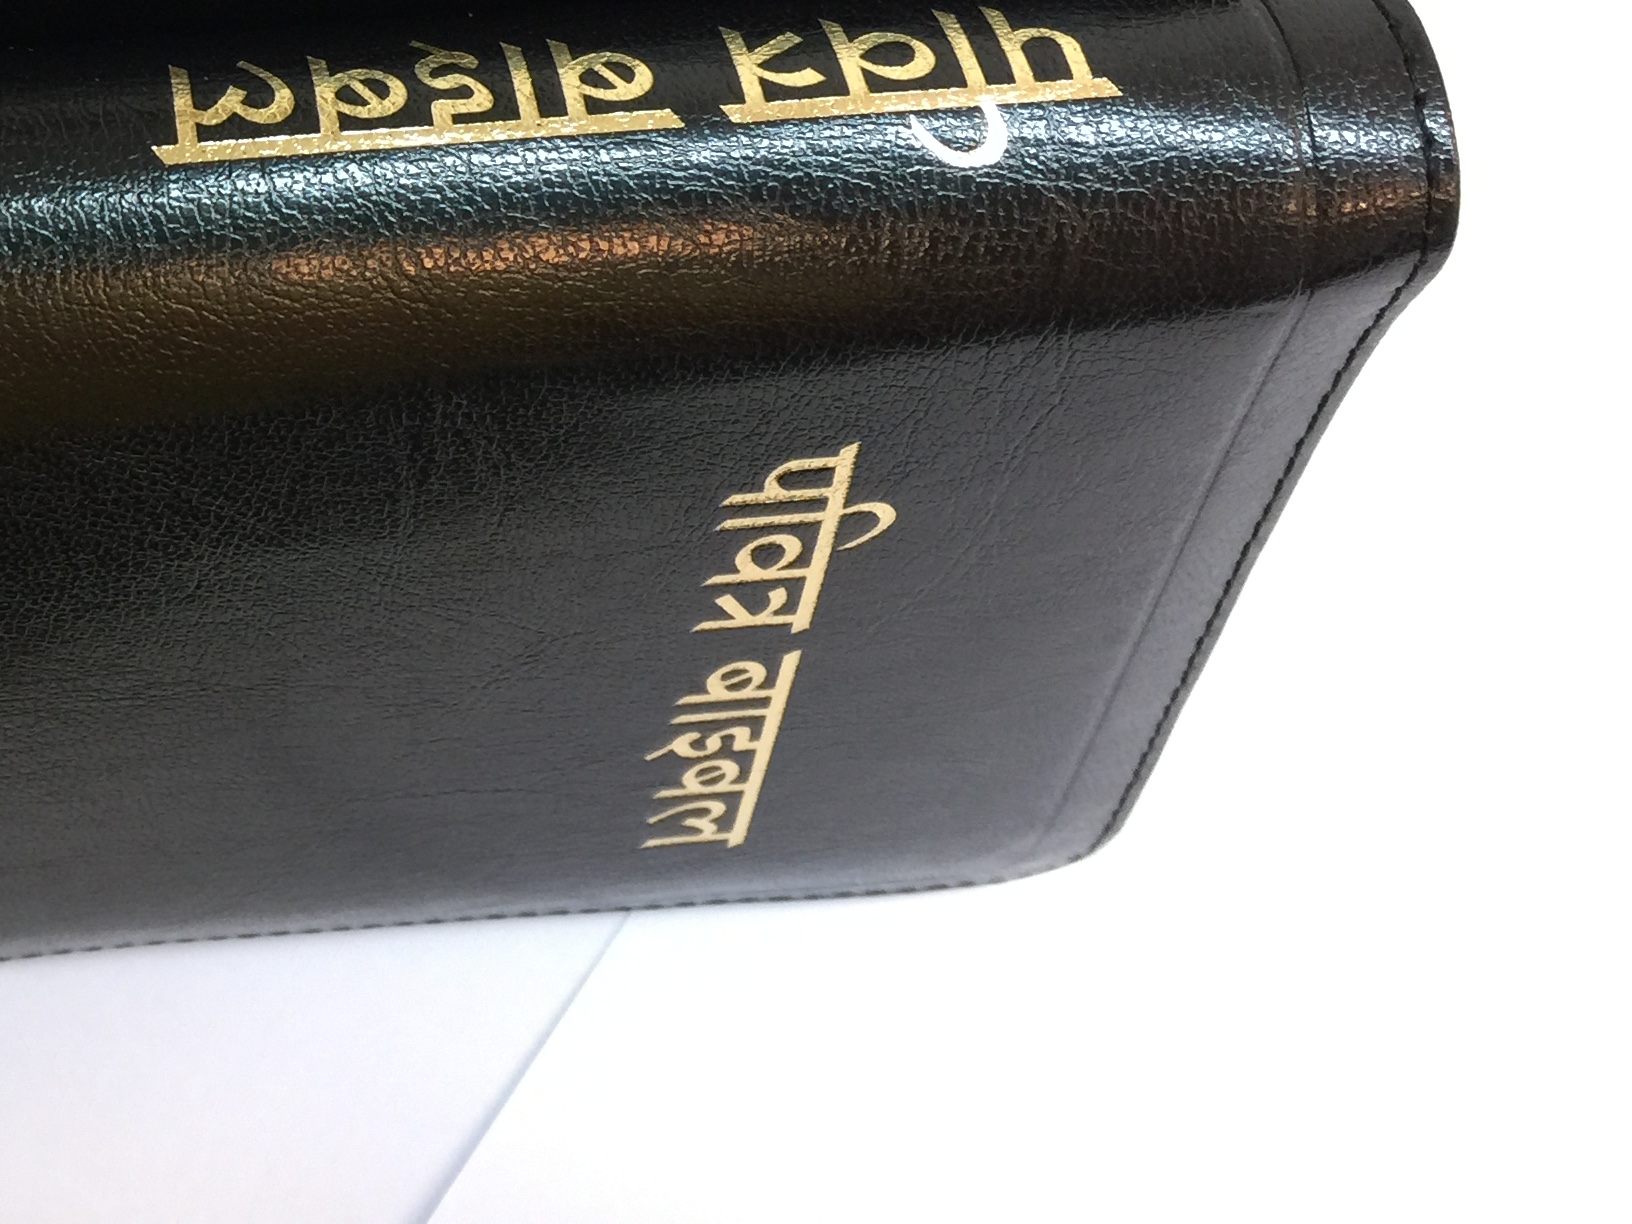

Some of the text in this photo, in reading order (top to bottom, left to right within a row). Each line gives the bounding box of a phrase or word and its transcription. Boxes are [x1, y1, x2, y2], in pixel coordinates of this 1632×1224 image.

[152, 6, 1123, 168] पवित्र बाइबल
[640, 441, 898, 847] पवित्र बाइबल
